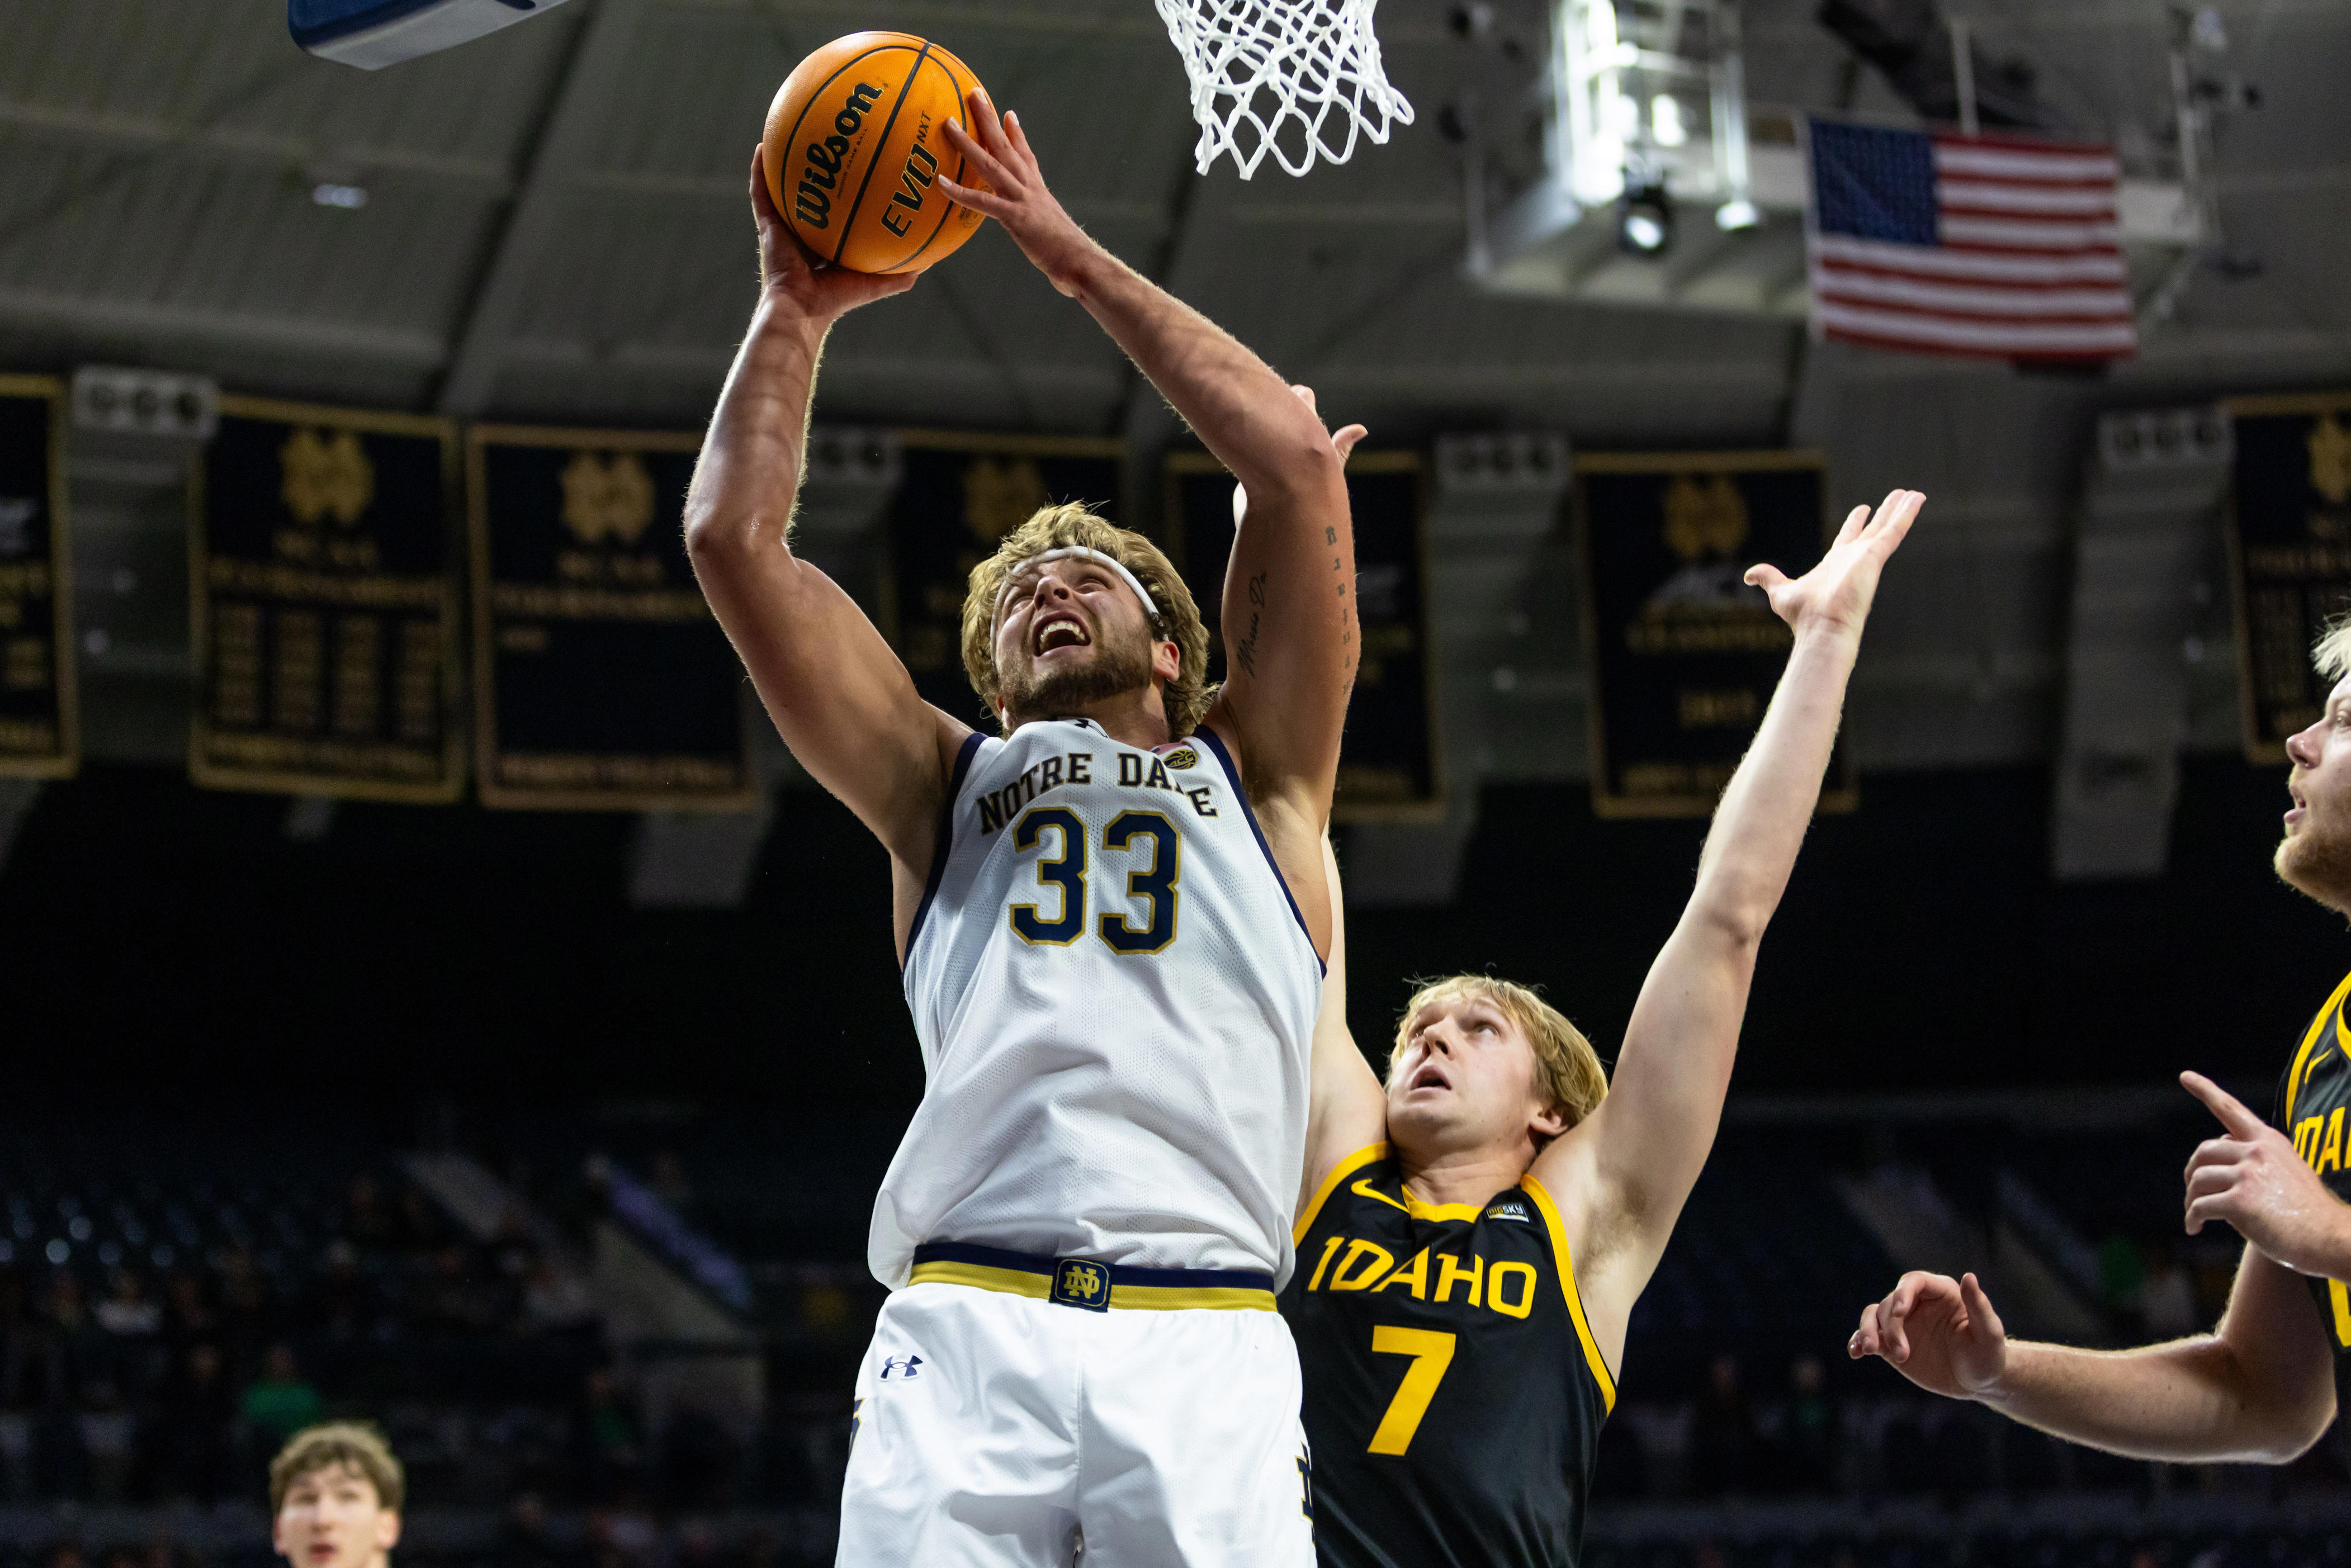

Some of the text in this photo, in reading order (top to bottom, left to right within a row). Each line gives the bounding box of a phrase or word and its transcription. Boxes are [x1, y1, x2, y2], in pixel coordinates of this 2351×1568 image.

[794, 82, 883, 229] Wilson
[838, 128, 868, 200] INDOOR GAME BALL
[916, 110, 933, 144] NXT
[976, 752, 1218, 836] NOTRE DAE
[1010, 806, 1181, 955] 33
[2293, 1106, 2351, 1174] IDA
[1307, 1236, 1537, 1319] IDAHO
[1367, 1324, 1456, 1457] 7
